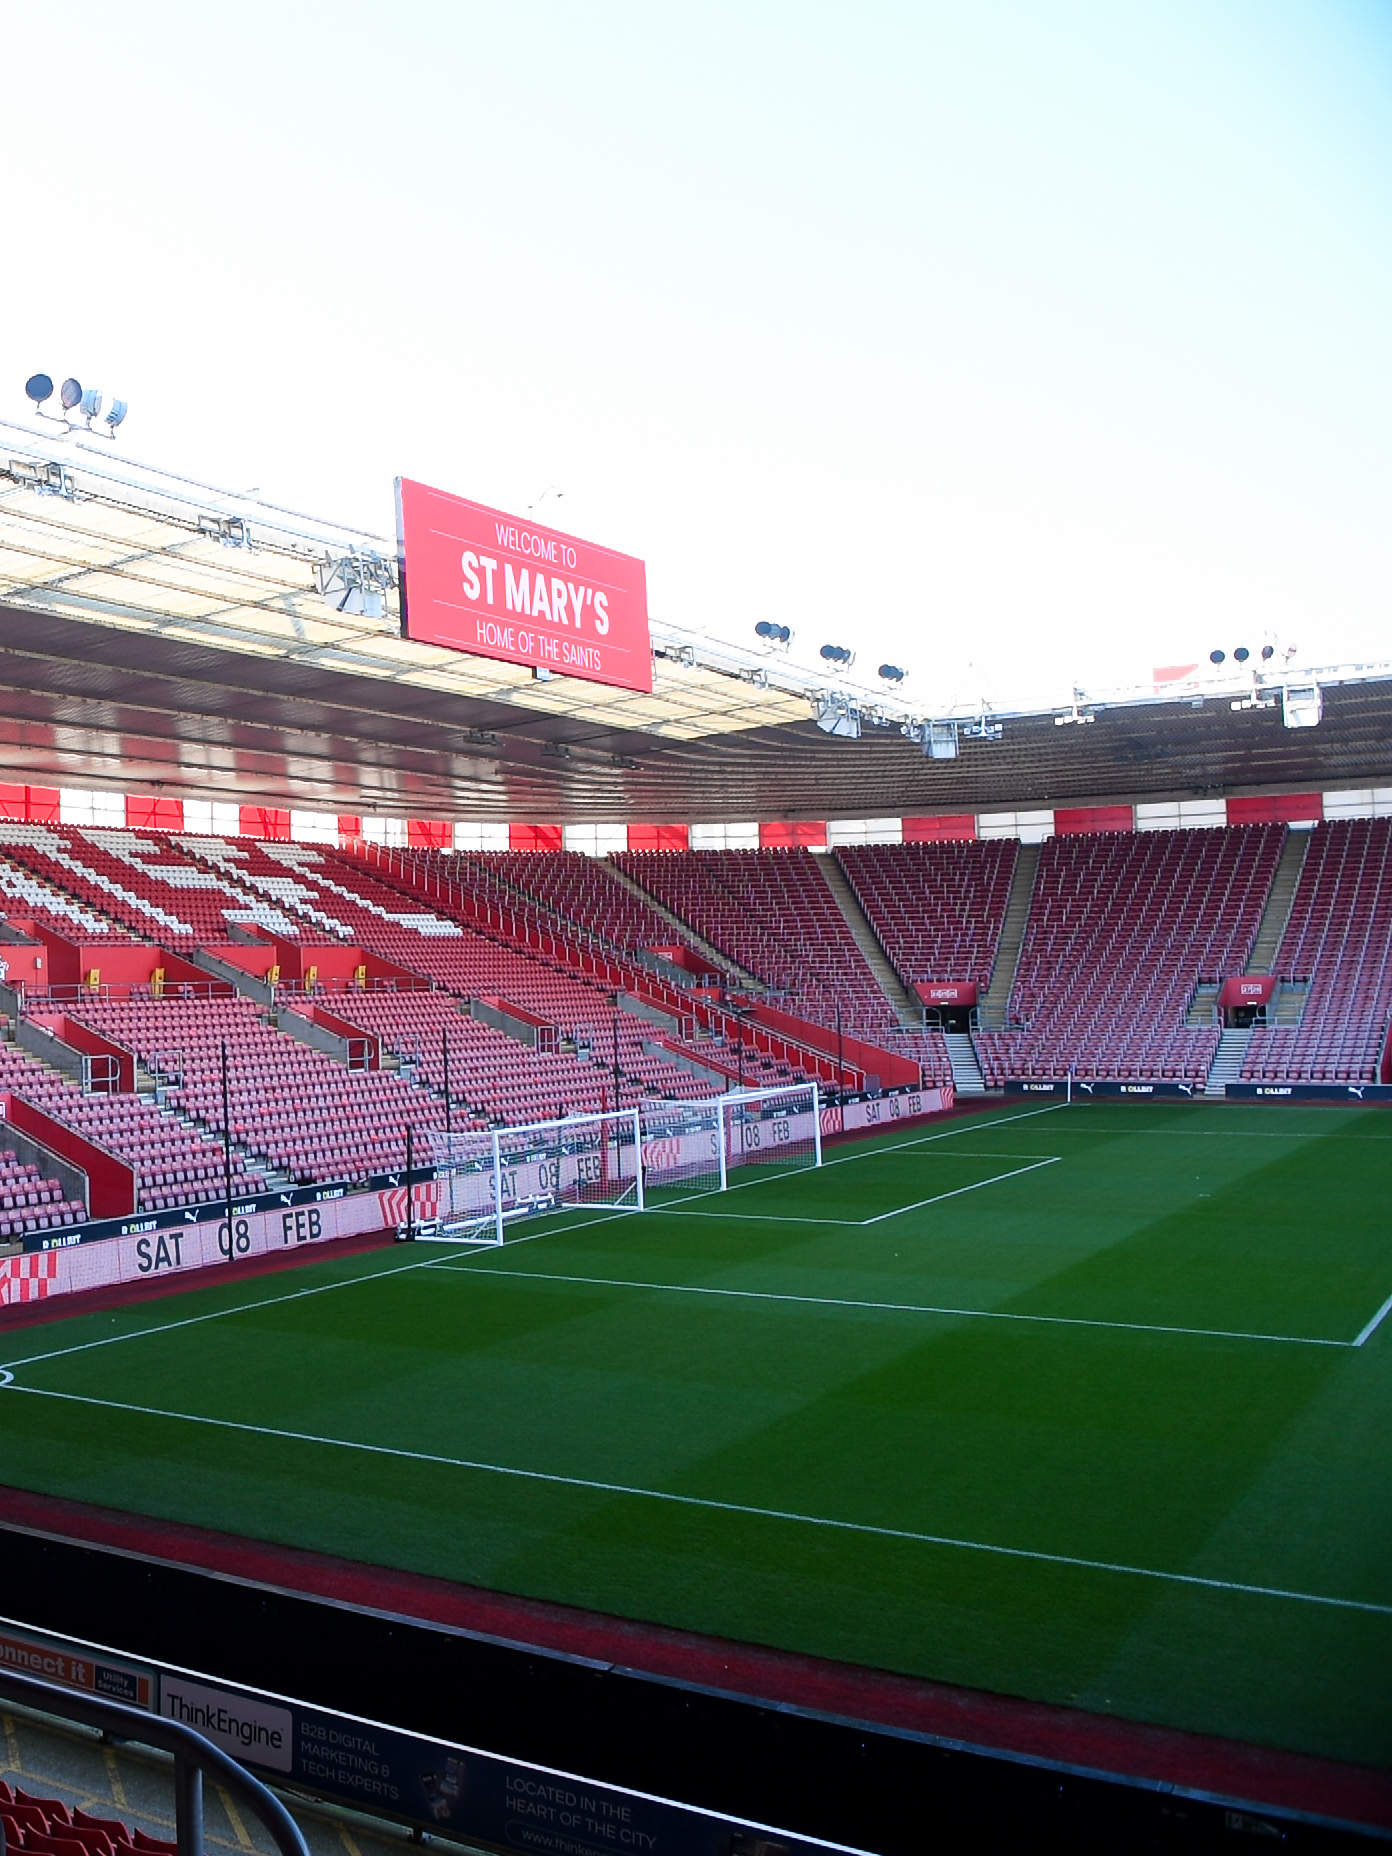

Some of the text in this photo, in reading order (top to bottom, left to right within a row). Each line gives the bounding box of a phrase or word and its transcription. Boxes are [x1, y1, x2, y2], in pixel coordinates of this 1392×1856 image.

[495, 522, 577, 569] WELCOME TO
[461, 550, 609, 635] ST MARY'S
[476, 620, 601, 671] HOME OF THE SAINTS
[865, 1095, 922, 1123] SAT 08 FEB
[745, 1125, 760, 1148] 08
[772, 1120, 790, 1143] FEB
[577, 1155, 602, 1183] FEB
[136, 1208, 322, 1273] SAT 08 FEB
[71, 1662, 86, 1684] it
[97, 1679, 134, 1698] Services
[102, 1670, 129, 1686] Utility
[167, 1693, 282, 1749] ThinkEngine
[300, 1721, 380, 1757] B2B DIGITAL
[300, 1740, 390, 1777] MARKETING &
[300, 1759, 399, 1800] TECH EXPERTS
[506, 1775, 631, 1822] LOCATED IN THE
[506, 1795, 657, 1849] HEART OF THE CITY
